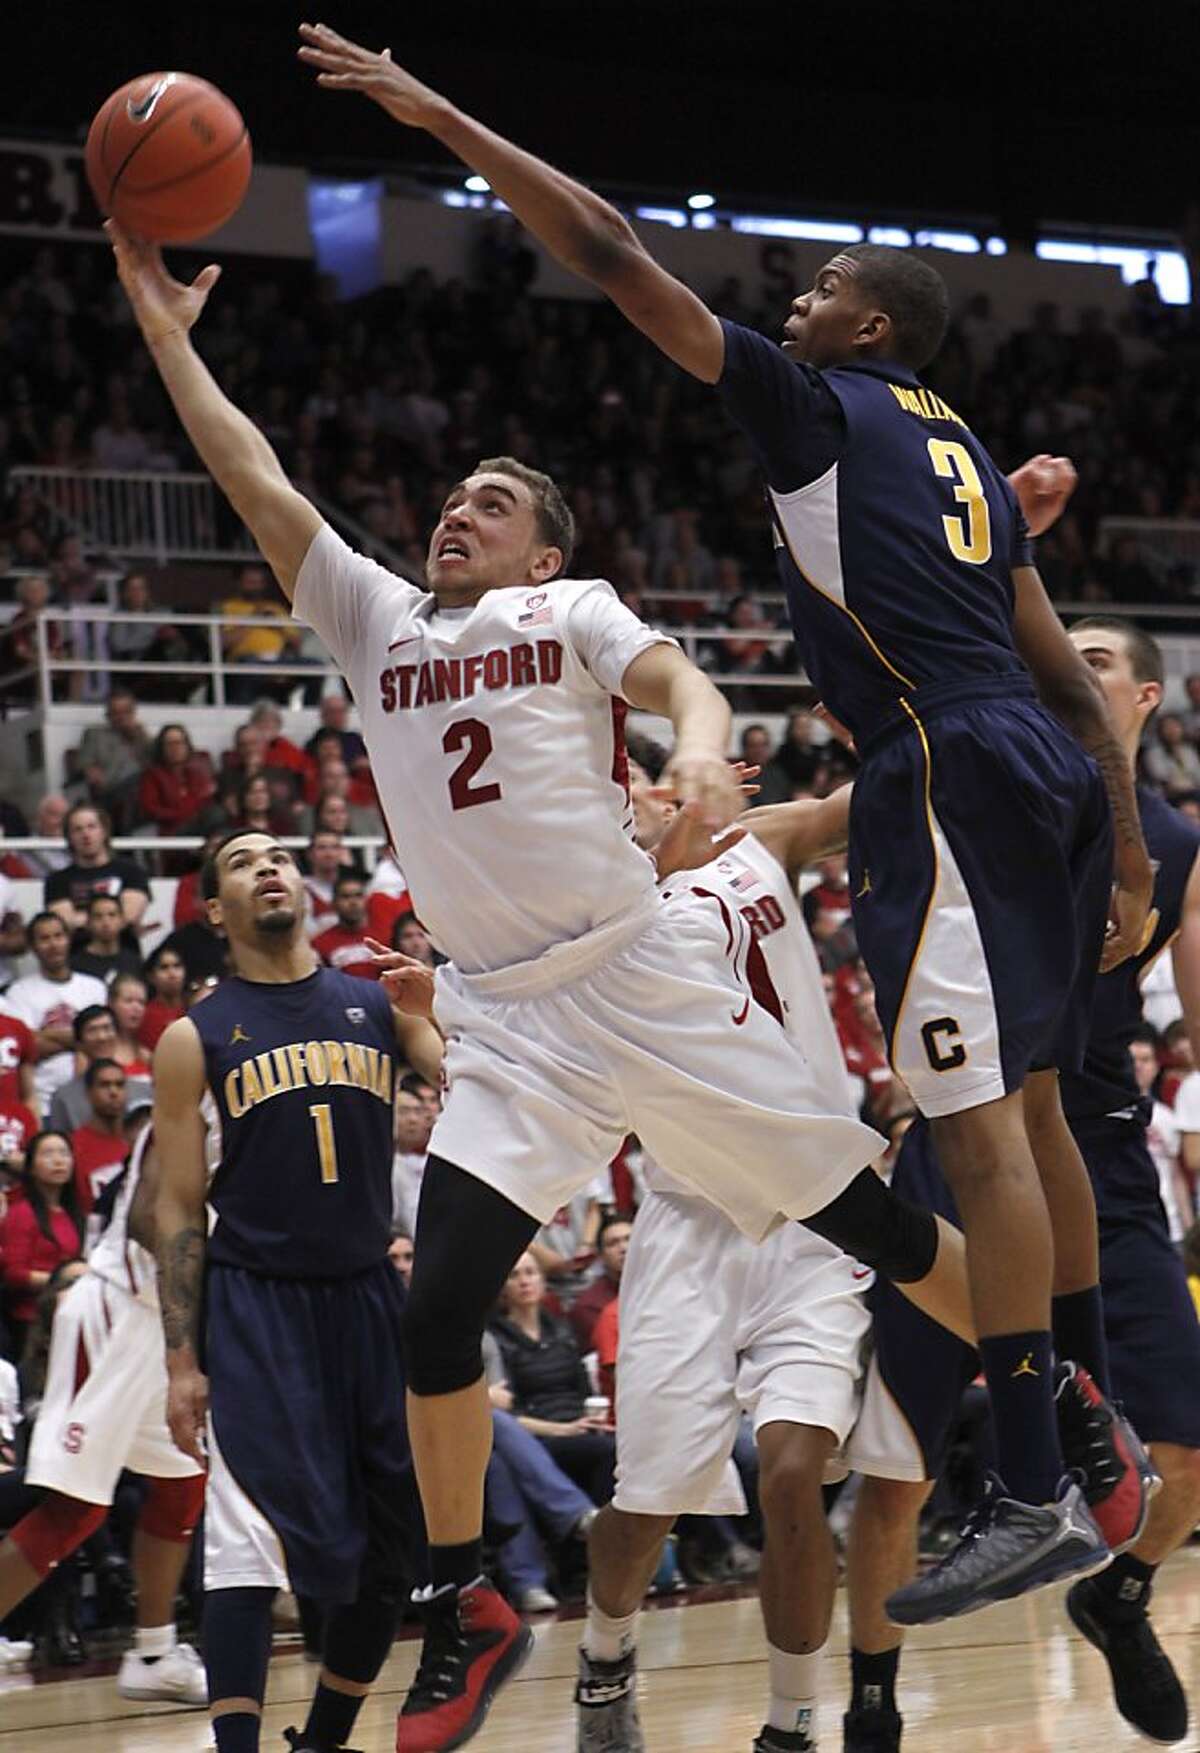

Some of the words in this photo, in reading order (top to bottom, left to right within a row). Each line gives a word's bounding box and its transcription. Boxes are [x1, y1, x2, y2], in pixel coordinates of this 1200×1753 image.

[927, 437, 992, 565] 3
[380, 640, 562, 713] STANFORD
[442, 717, 502, 811] 2
[224, 1040, 392, 1118] CALIFORNIA
[921, 1016, 967, 1073] C
[309, 1104, 339, 1184] 1
[64, 1422, 86, 1455] S
